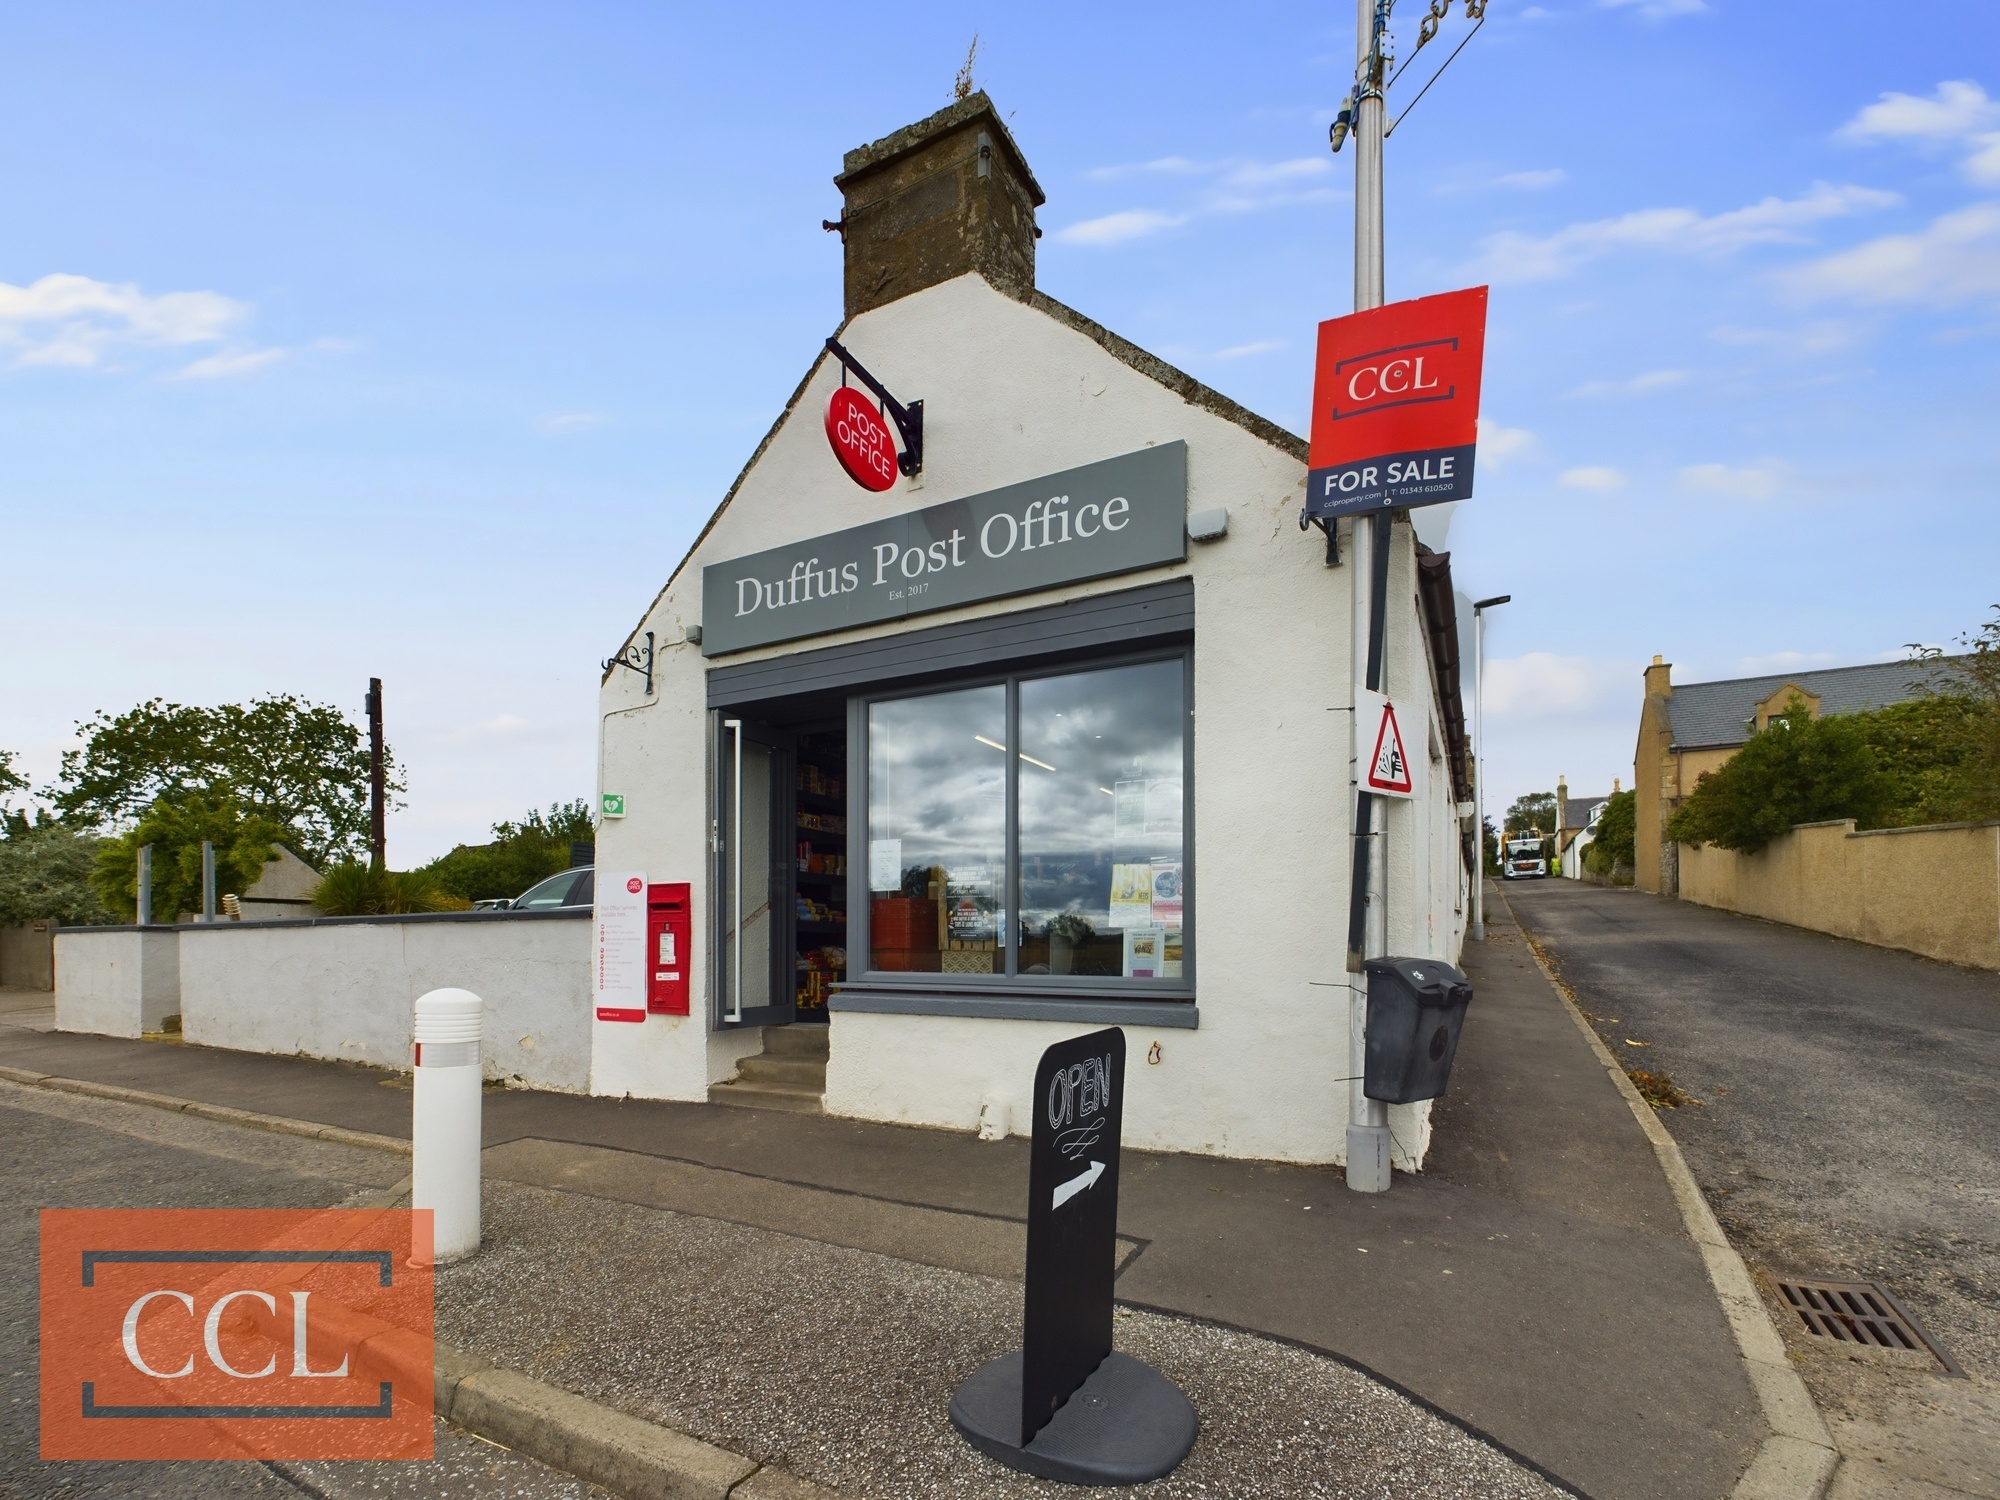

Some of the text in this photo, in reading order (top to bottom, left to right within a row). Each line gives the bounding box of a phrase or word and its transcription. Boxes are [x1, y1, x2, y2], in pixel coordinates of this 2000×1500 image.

[1348, 357, 1438, 401] CCL
[848, 402, 886, 451] POST
[837, 420, 891, 480] OFFICE
[1324, 456, 1455, 496] FOR SALE
[1324, 491, 1382, 508] cclproperty.com
[1399, 486, 1423, 495] 01343
[1424, 483, 1453, 493] 610520
[735, 495, 1130, 617] Duffus Post Office
[889, 583, 929, 601] Est. 2017
[1048, 1052, 1111, 1130] OPEN
